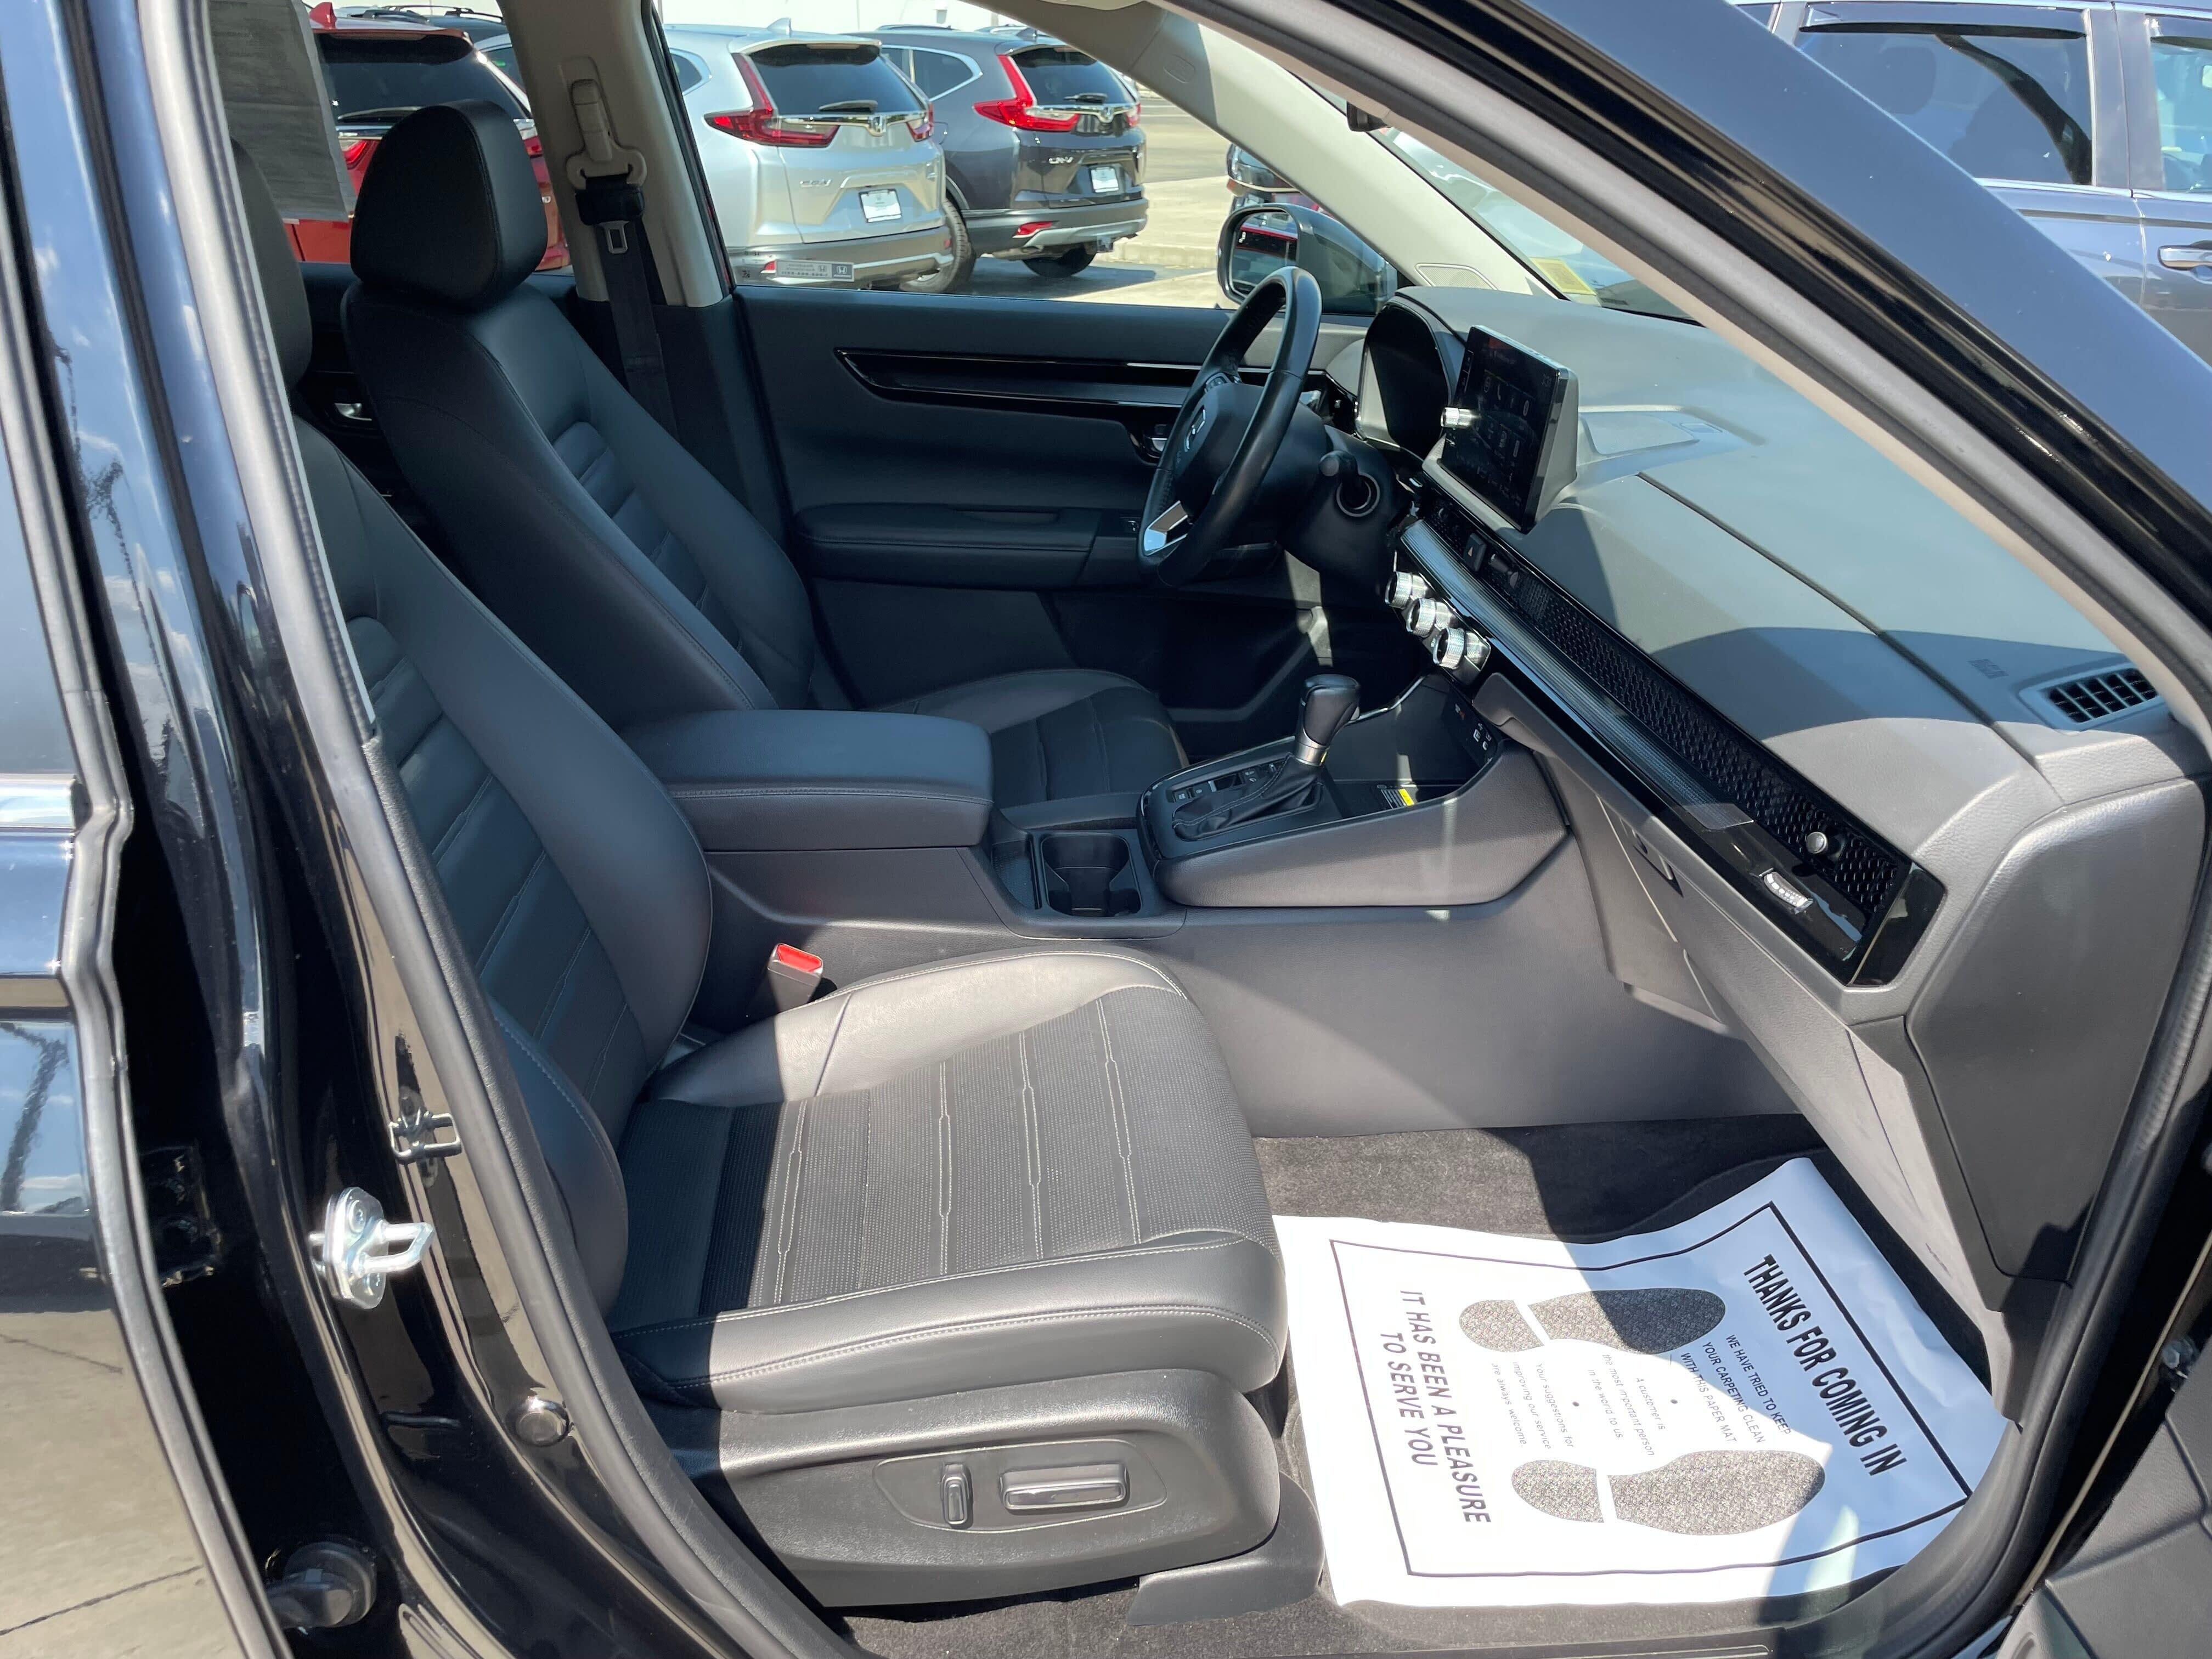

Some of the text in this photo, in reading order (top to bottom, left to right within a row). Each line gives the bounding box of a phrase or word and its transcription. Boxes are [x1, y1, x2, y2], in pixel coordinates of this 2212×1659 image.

[1380, 1333, 1438, 1465] TO SERVE YOU
[1400, 1290, 1491, 1522] IT HAS BEEN A PLEASURE
[1492, 1363, 1501, 1375] are
[1497, 1379, 1512, 1405] always
[1513, 1362, 1551, 1449] improving our service
[1536, 1363, 1574, 1447] Your suggestions for
[1592, 1379, 1603, 1390] the
[1599, 1393, 1613, 1414] world
[1602, 1354, 1655, 1455] the most important person
[1639, 1385, 1661, 1420] customer
[1681, 1352, 1737, 1442] WITH THIS PAPER MAT
[1702, 1342, 1765, 1443] YOUR CARPETING CLEAN
[1726, 1335, 1791, 1434] WE HAVE TRIED TO KEEP
[1743, 1254, 1906, 1476] THANKS FOR COMING IN
